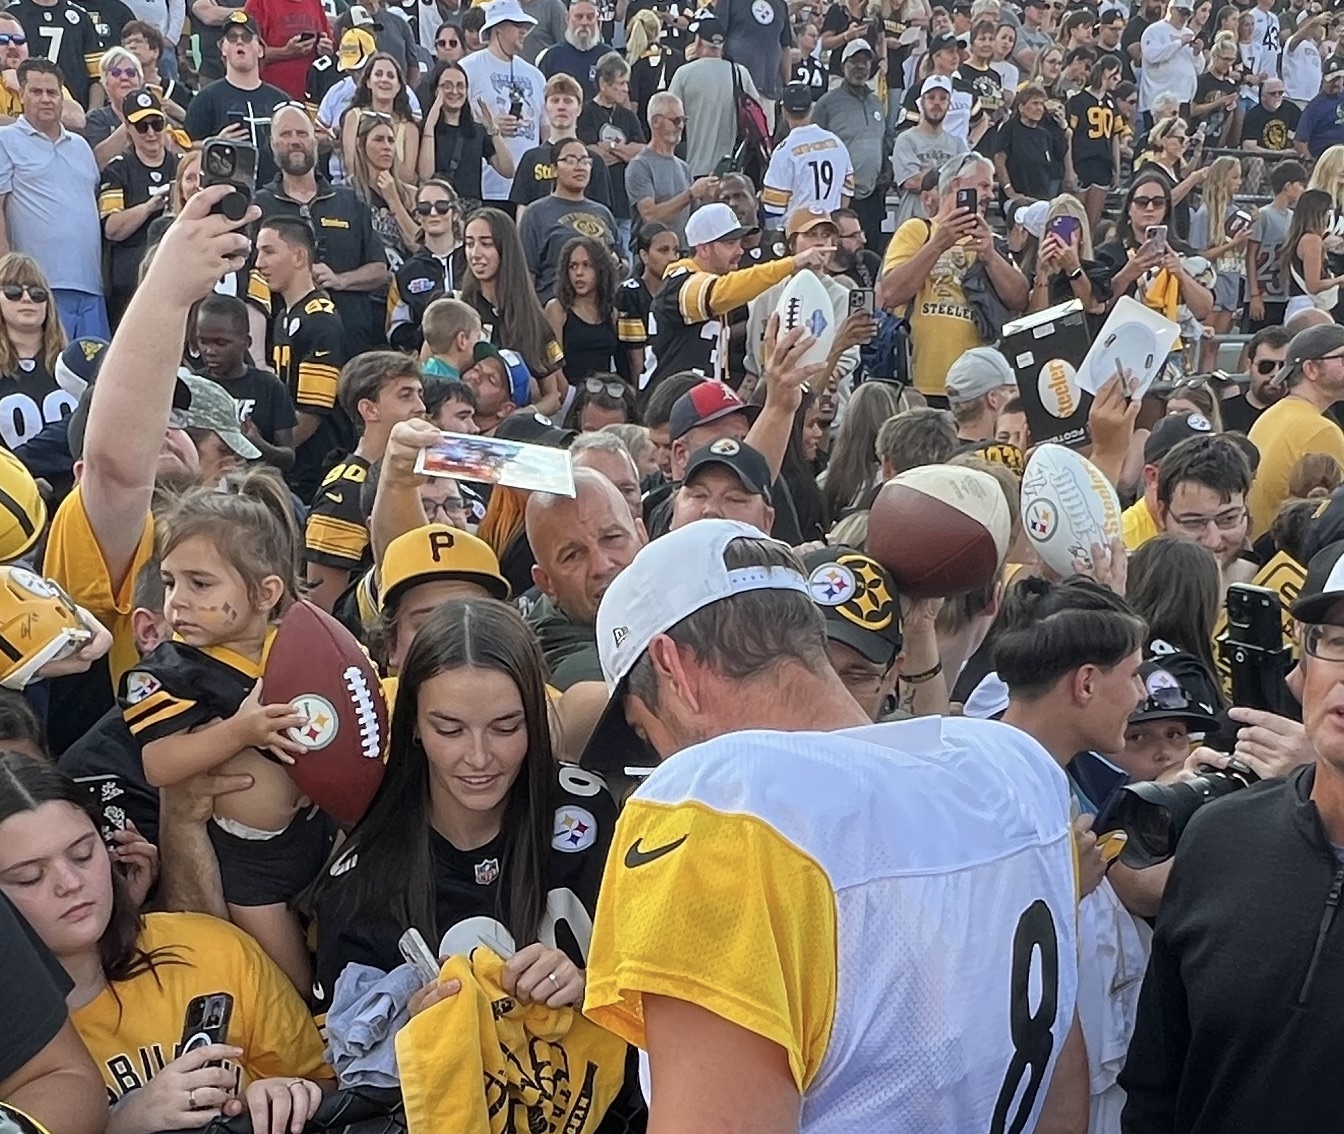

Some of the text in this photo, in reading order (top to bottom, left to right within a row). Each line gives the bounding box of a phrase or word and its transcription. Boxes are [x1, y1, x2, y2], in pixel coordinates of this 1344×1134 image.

[39, 26, 64, 64] 7
[1087, 106, 1115, 139] 90
[808, 160, 834, 201] 19
[321, 463, 366, 487] 90
[428, 532, 455, 562] P
